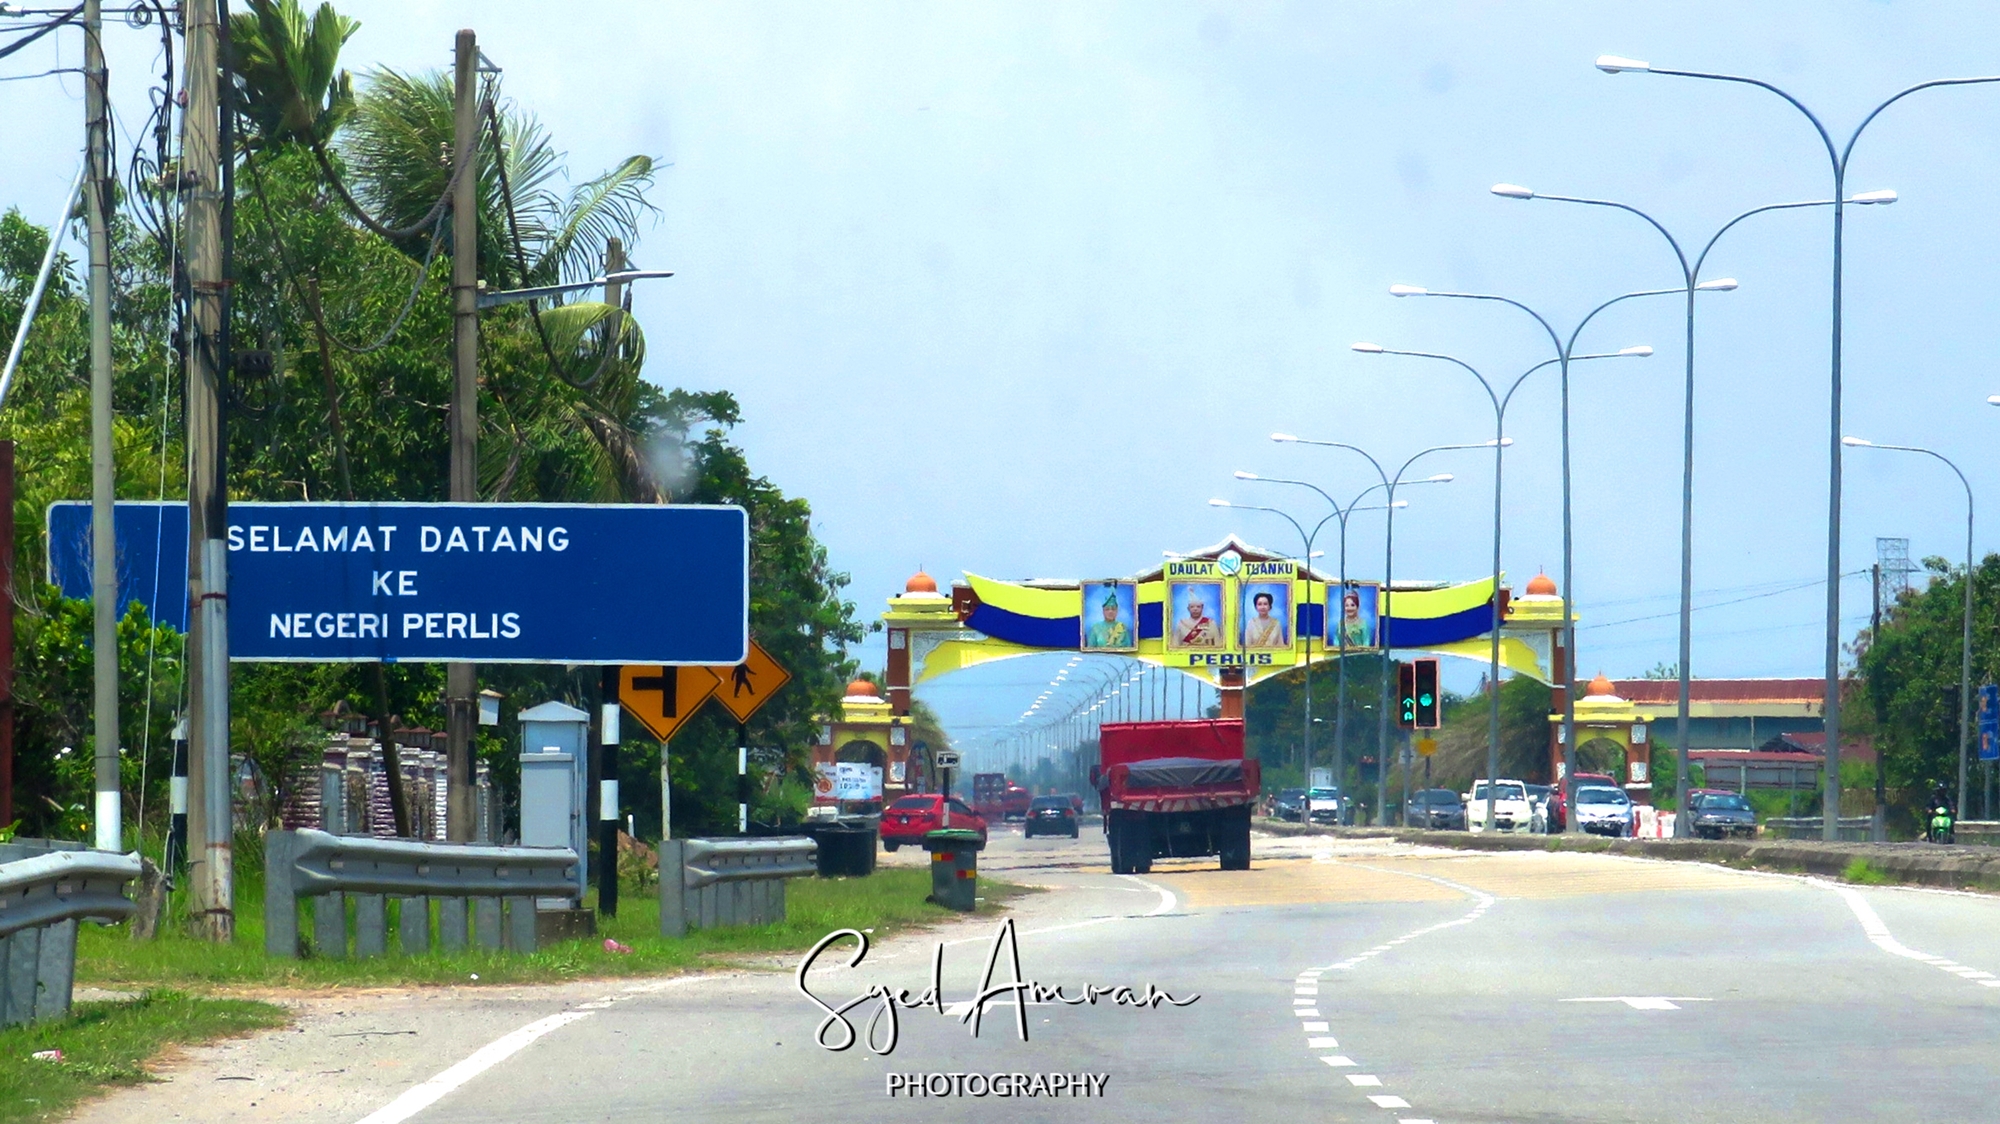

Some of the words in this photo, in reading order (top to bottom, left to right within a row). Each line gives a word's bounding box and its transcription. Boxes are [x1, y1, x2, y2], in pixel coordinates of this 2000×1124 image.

[227, 526, 397, 552] SELAMAT
[420, 526, 570, 552] DATANG
[1169, 563, 1214, 575] DAULAT
[1245, 563, 1293, 575] TUANKU
[372, 570, 418, 596] KE
[269, 613, 388, 638] NEGERI
[403, 613, 521, 639] PERLIS
[1189, 653, 1272, 666] PERLIS
